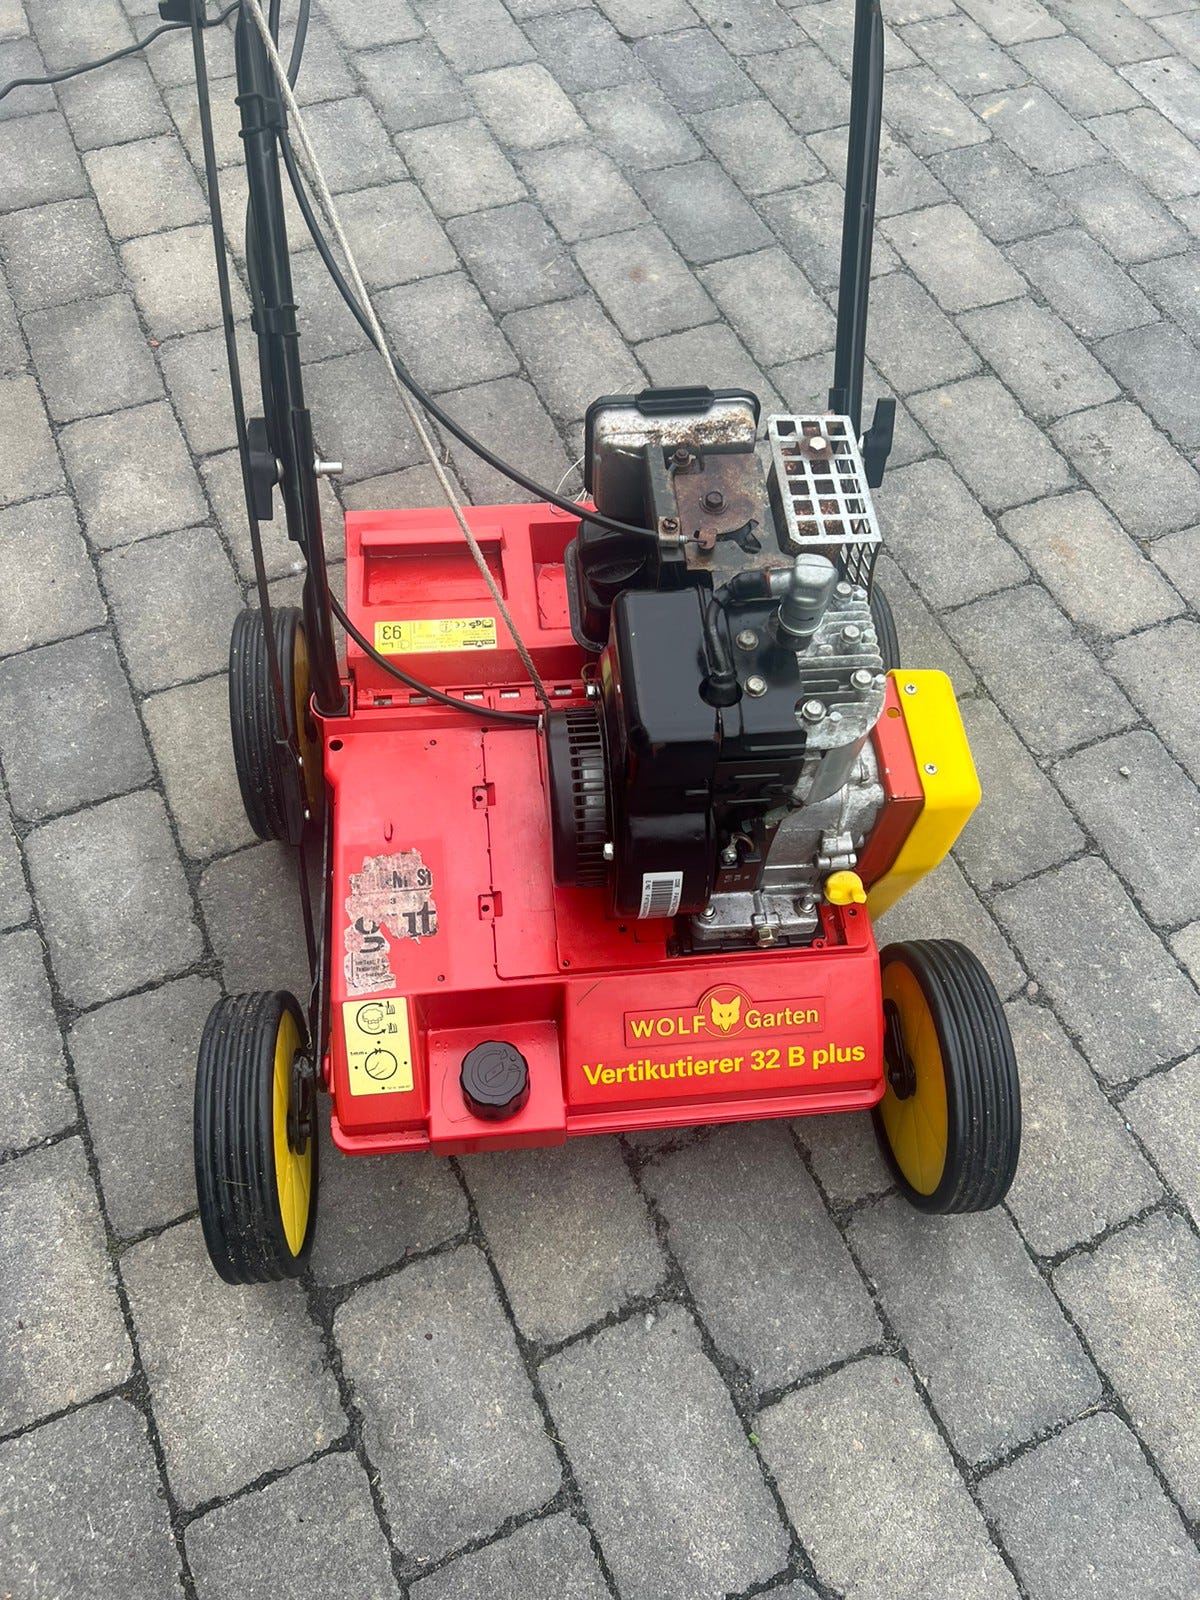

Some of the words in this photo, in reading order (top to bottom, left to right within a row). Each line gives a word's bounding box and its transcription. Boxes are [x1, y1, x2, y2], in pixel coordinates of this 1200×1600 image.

[382, 625, 401, 640] 93
[630, 1014, 706, 1039] WOLF
[745, 1007, 819, 1029] Garten
[583, 1053, 744, 1086] Vertikutierer
[750, 1048, 780, 1071] 32
[788, 1045, 805, 1067] B
[812, 1043, 866, 1071] plus
